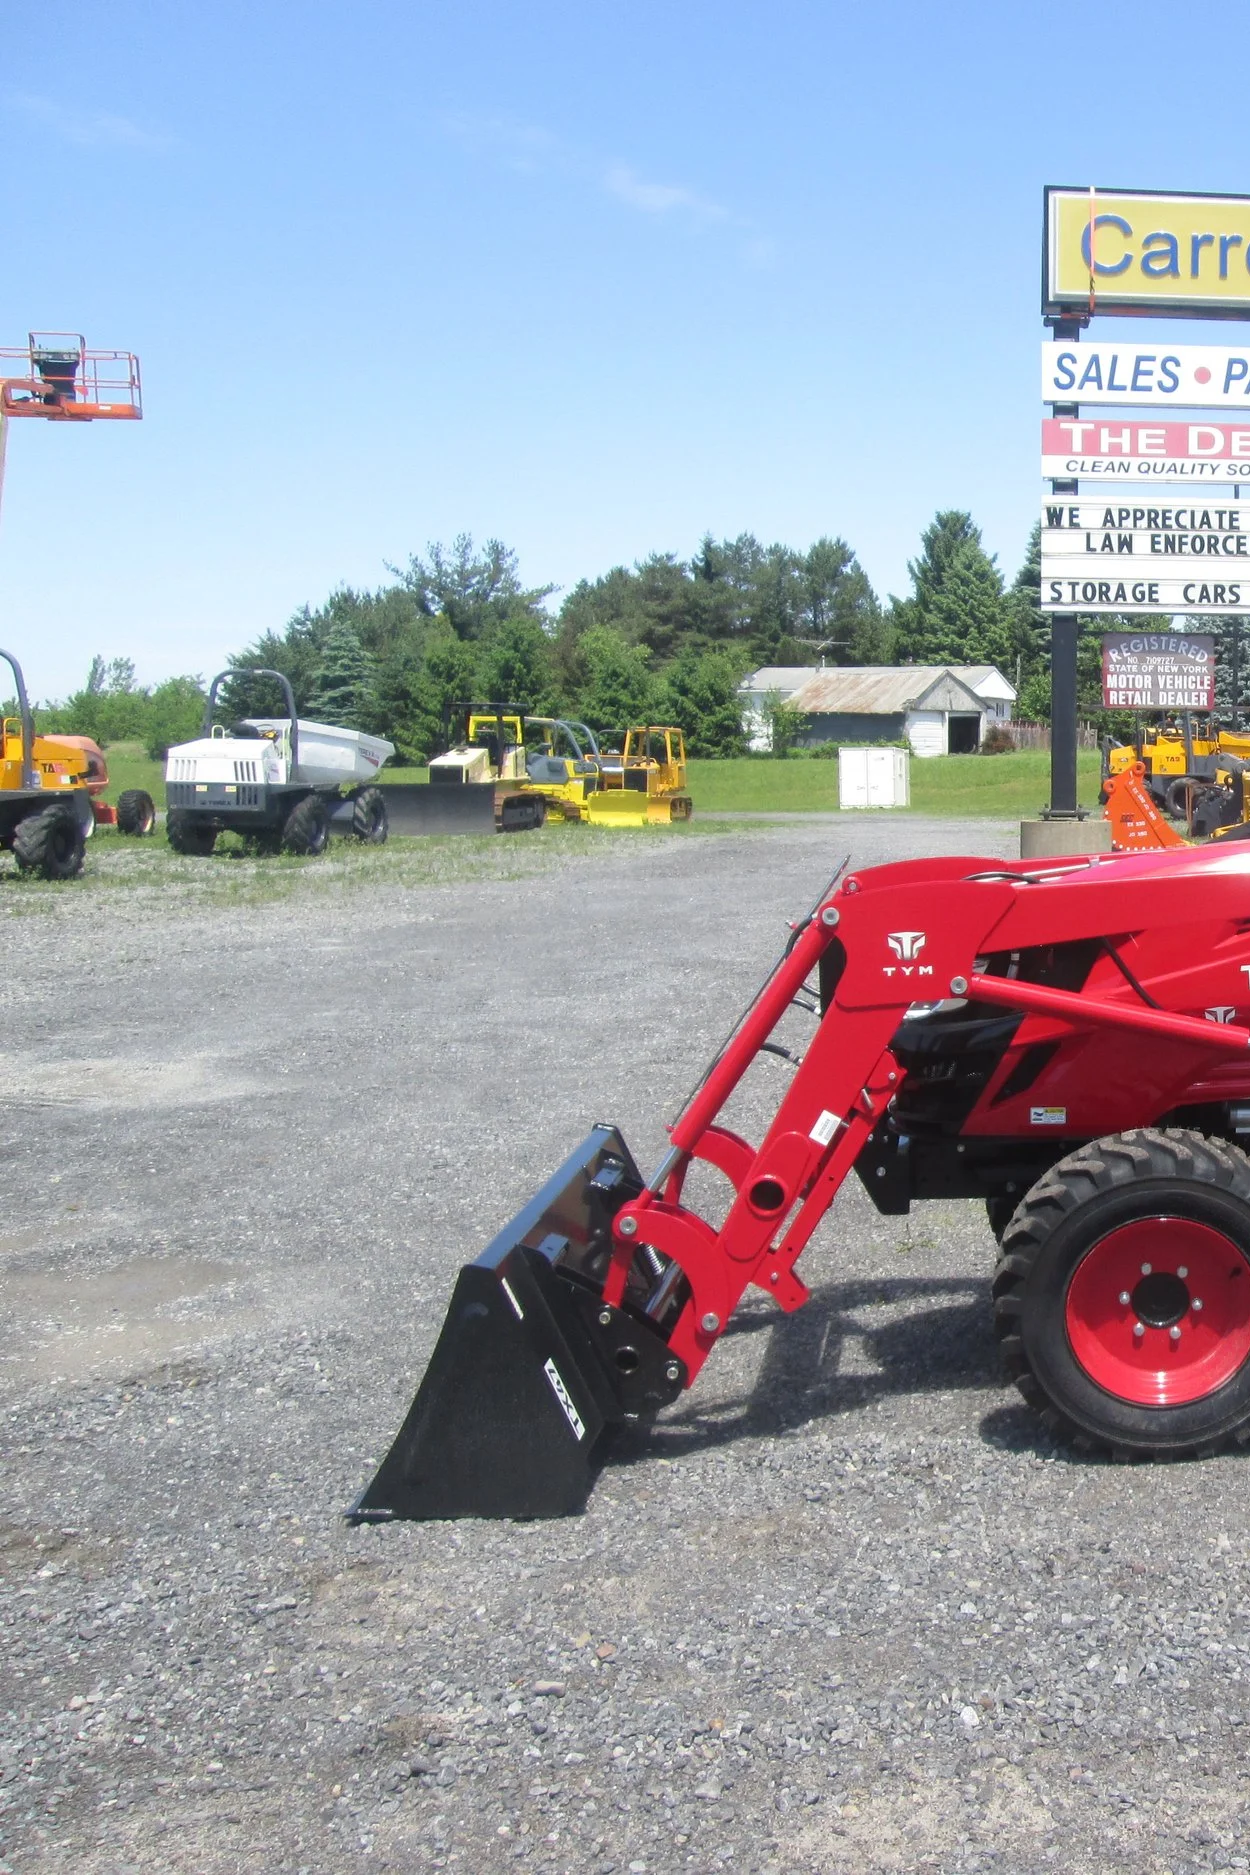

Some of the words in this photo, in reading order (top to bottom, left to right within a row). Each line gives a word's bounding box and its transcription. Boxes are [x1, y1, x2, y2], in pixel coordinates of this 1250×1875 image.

[1053, 352, 1181, 393] SALES
[1060, 422, 1167, 455] THE
[1065, 460, 1131, 473] CLEAN
[1136, 461, 1221, 476] QUALITY
[1046, 506, 1080, 527] WE
[1102, 508, 1240, 530] APPRECIATE
[1085, 533, 1133, 553] LAW
[1050, 581, 1159, 603] STORAGE
[1183, 583, 1241, 605] CARS
[1109, 636, 1208, 662] REGISTERED
[1157, 665, 1178, 673] NEW
[1107, 674, 1152, 688] MOTOR
[1157, 675, 1211, 689] VEHICLE
[1109, 691, 1154, 705] RETAIL
[1159, 691, 1208, 706] DEALER
[883, 965, 933, 977] TYM
